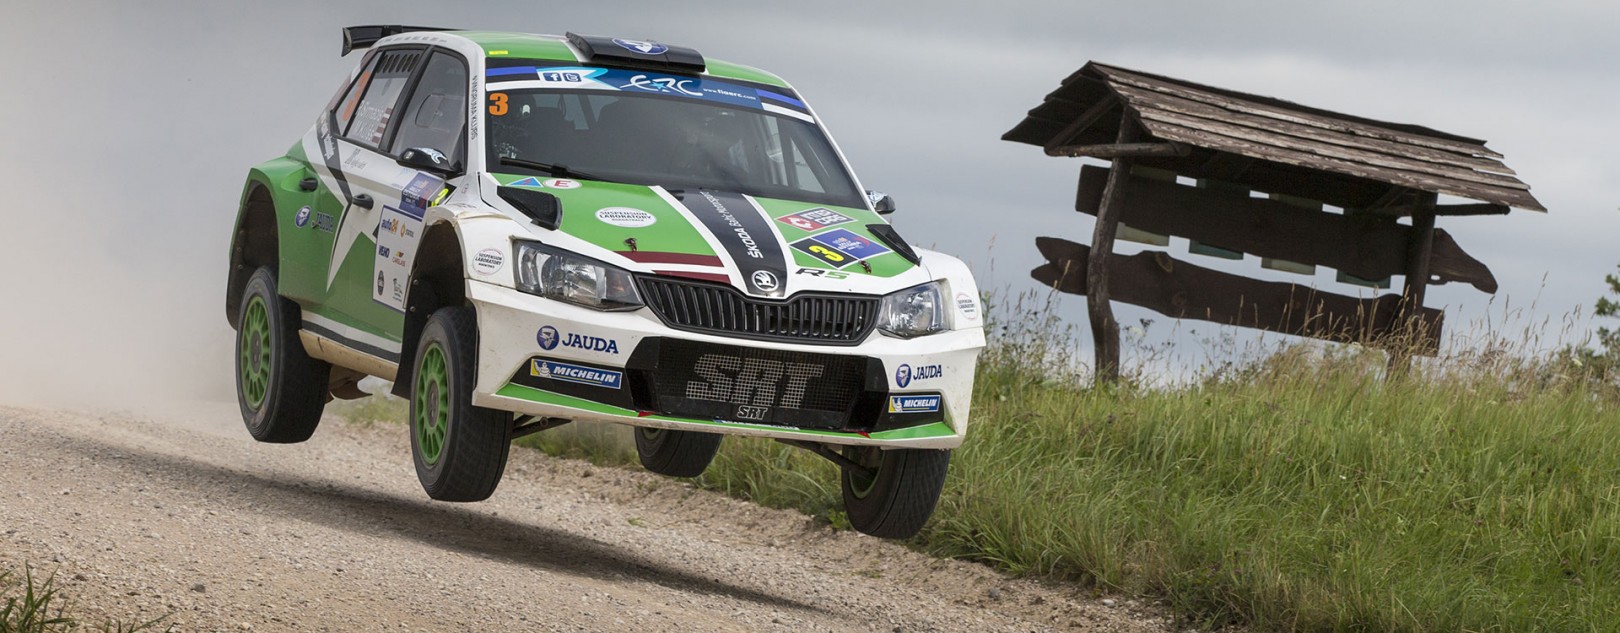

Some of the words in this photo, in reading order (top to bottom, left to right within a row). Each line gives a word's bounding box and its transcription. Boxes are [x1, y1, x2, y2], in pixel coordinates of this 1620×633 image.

[620, 74, 703, 97] ERC
[702, 88, 757, 101] www.fiaerc.com
[488, 93, 509, 116] 3
[554, 180, 571, 188] E
[381, 217, 399, 235] auto24
[378, 245, 390, 258] VEHO
[734, 227, 764, 259] ŠKODA
[475, 257, 502, 266] LABORATORY
[479, 253, 502, 261] SUSPENSION
[808, 245, 845, 262] 3
[795, 267, 850, 280] R5
[562, 333, 619, 354] JAUDA
[552, 365, 616, 384] MICHELIN
[686, 353, 825, 409] SRT
[912, 364, 943, 381] JAUDA
[903, 397, 938, 409] MICHELIN
[736, 405, 768, 420] SRT
